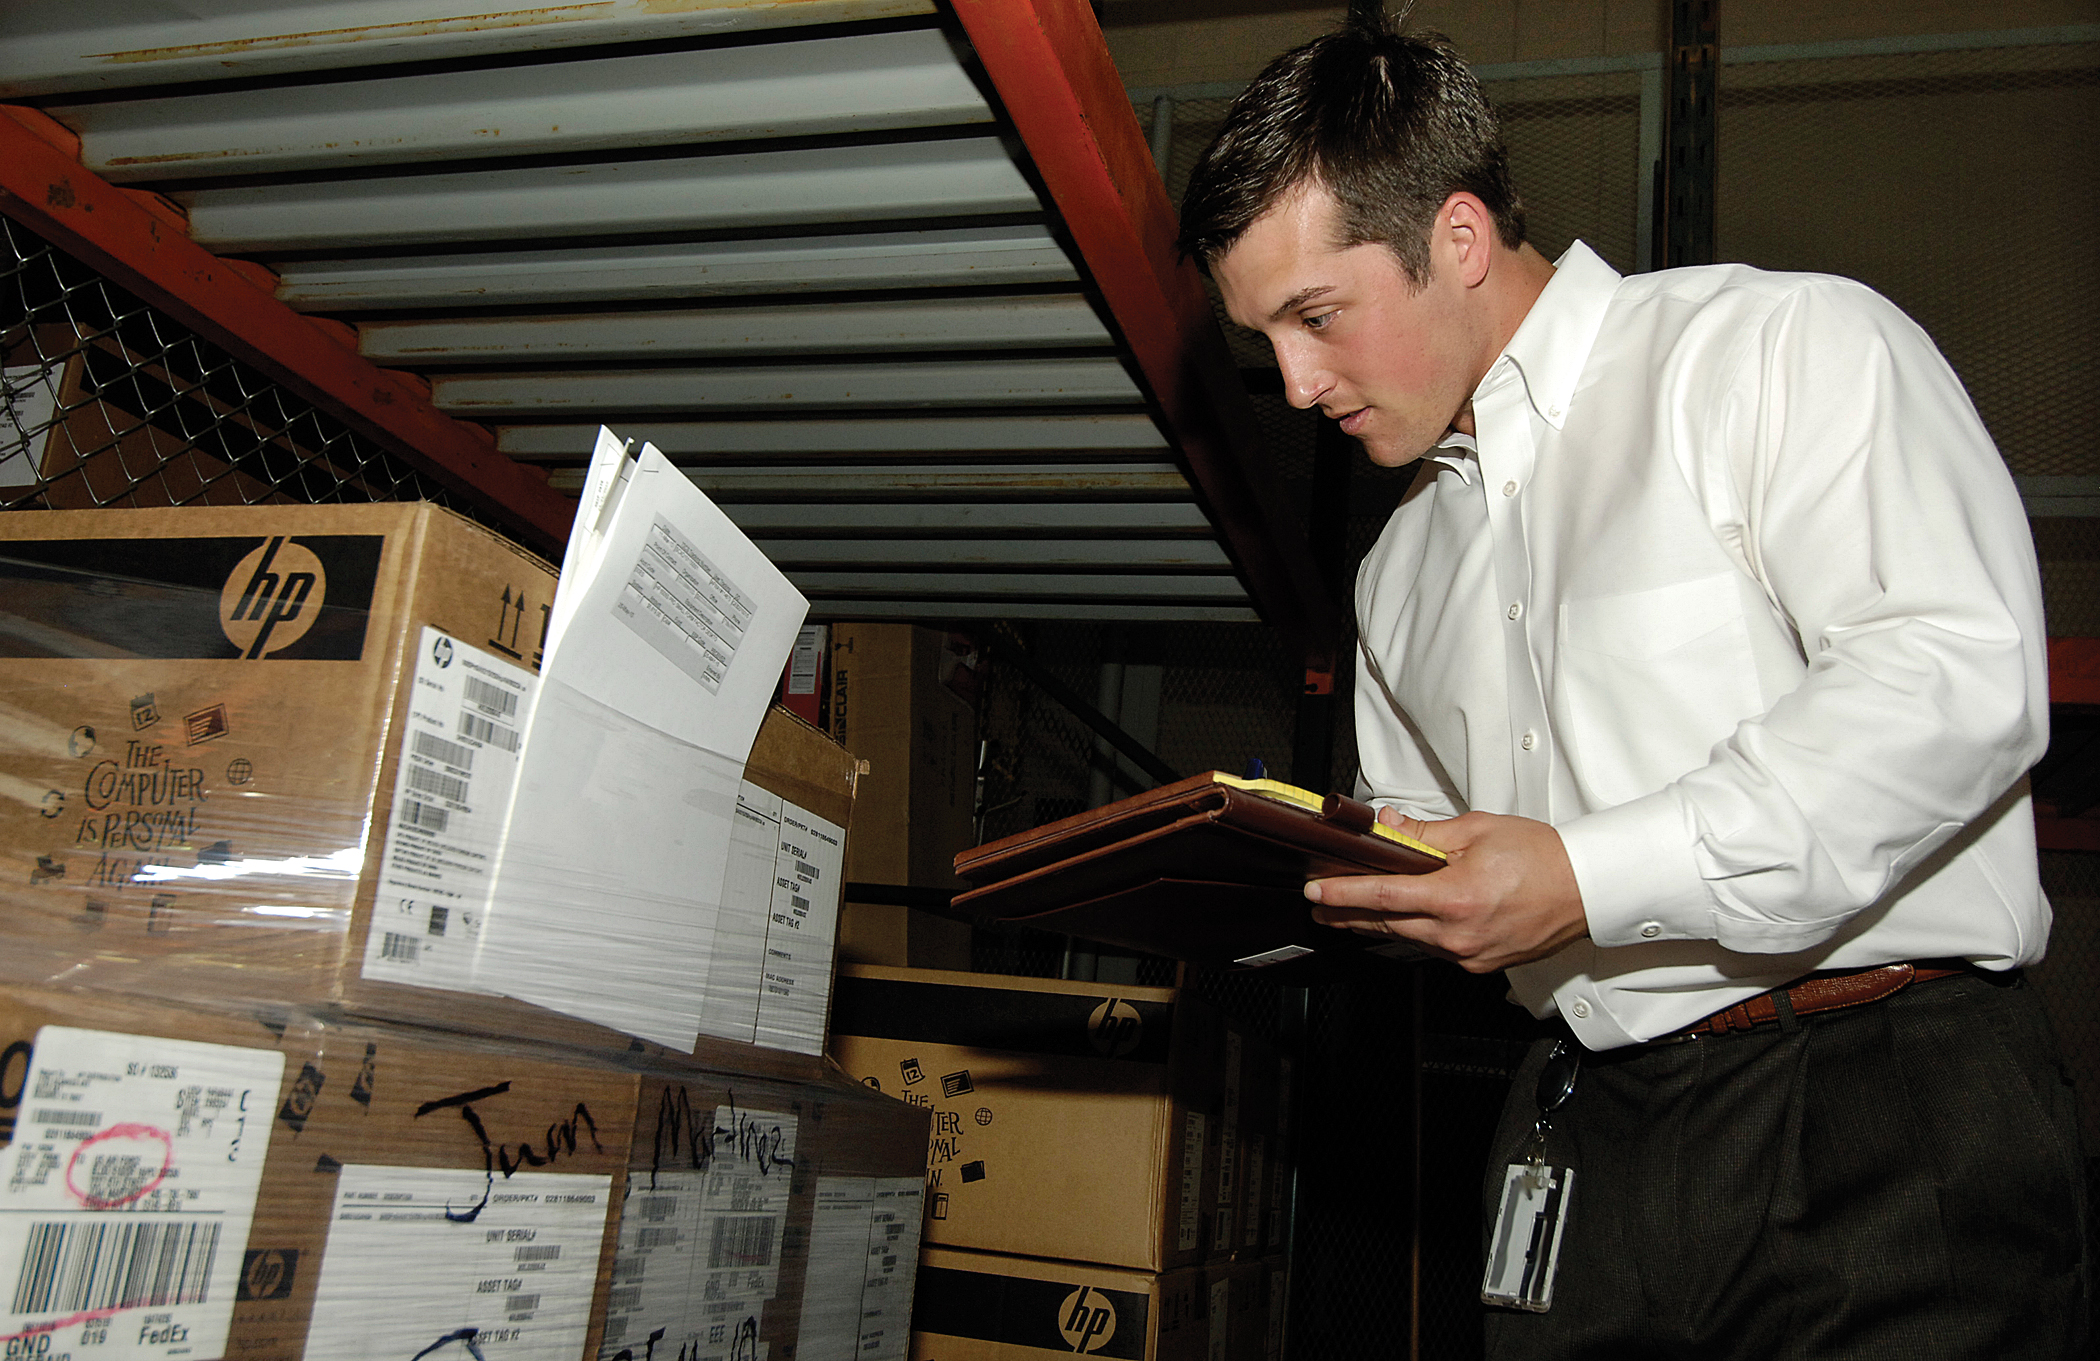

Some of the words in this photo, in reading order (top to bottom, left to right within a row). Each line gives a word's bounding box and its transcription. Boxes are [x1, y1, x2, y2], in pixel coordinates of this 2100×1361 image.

[125, 740, 163, 770] THE
[85, 758, 209, 811] COMPUTER
[76, 818, 98, 844] IS
[101, 806, 201, 852] PERSONAL
[486, 1230, 504, 1243] UNIT
[506, 1229, 537, 1243] SERIAL#
[476, 1280, 502, 1293] ASSET
[1064, 1285, 1111, 1354] hp
[7, 1334, 52, 1357] GND
[137, 1325, 190, 1346] FedEx
[494, 1329, 510, 1342] TAG
